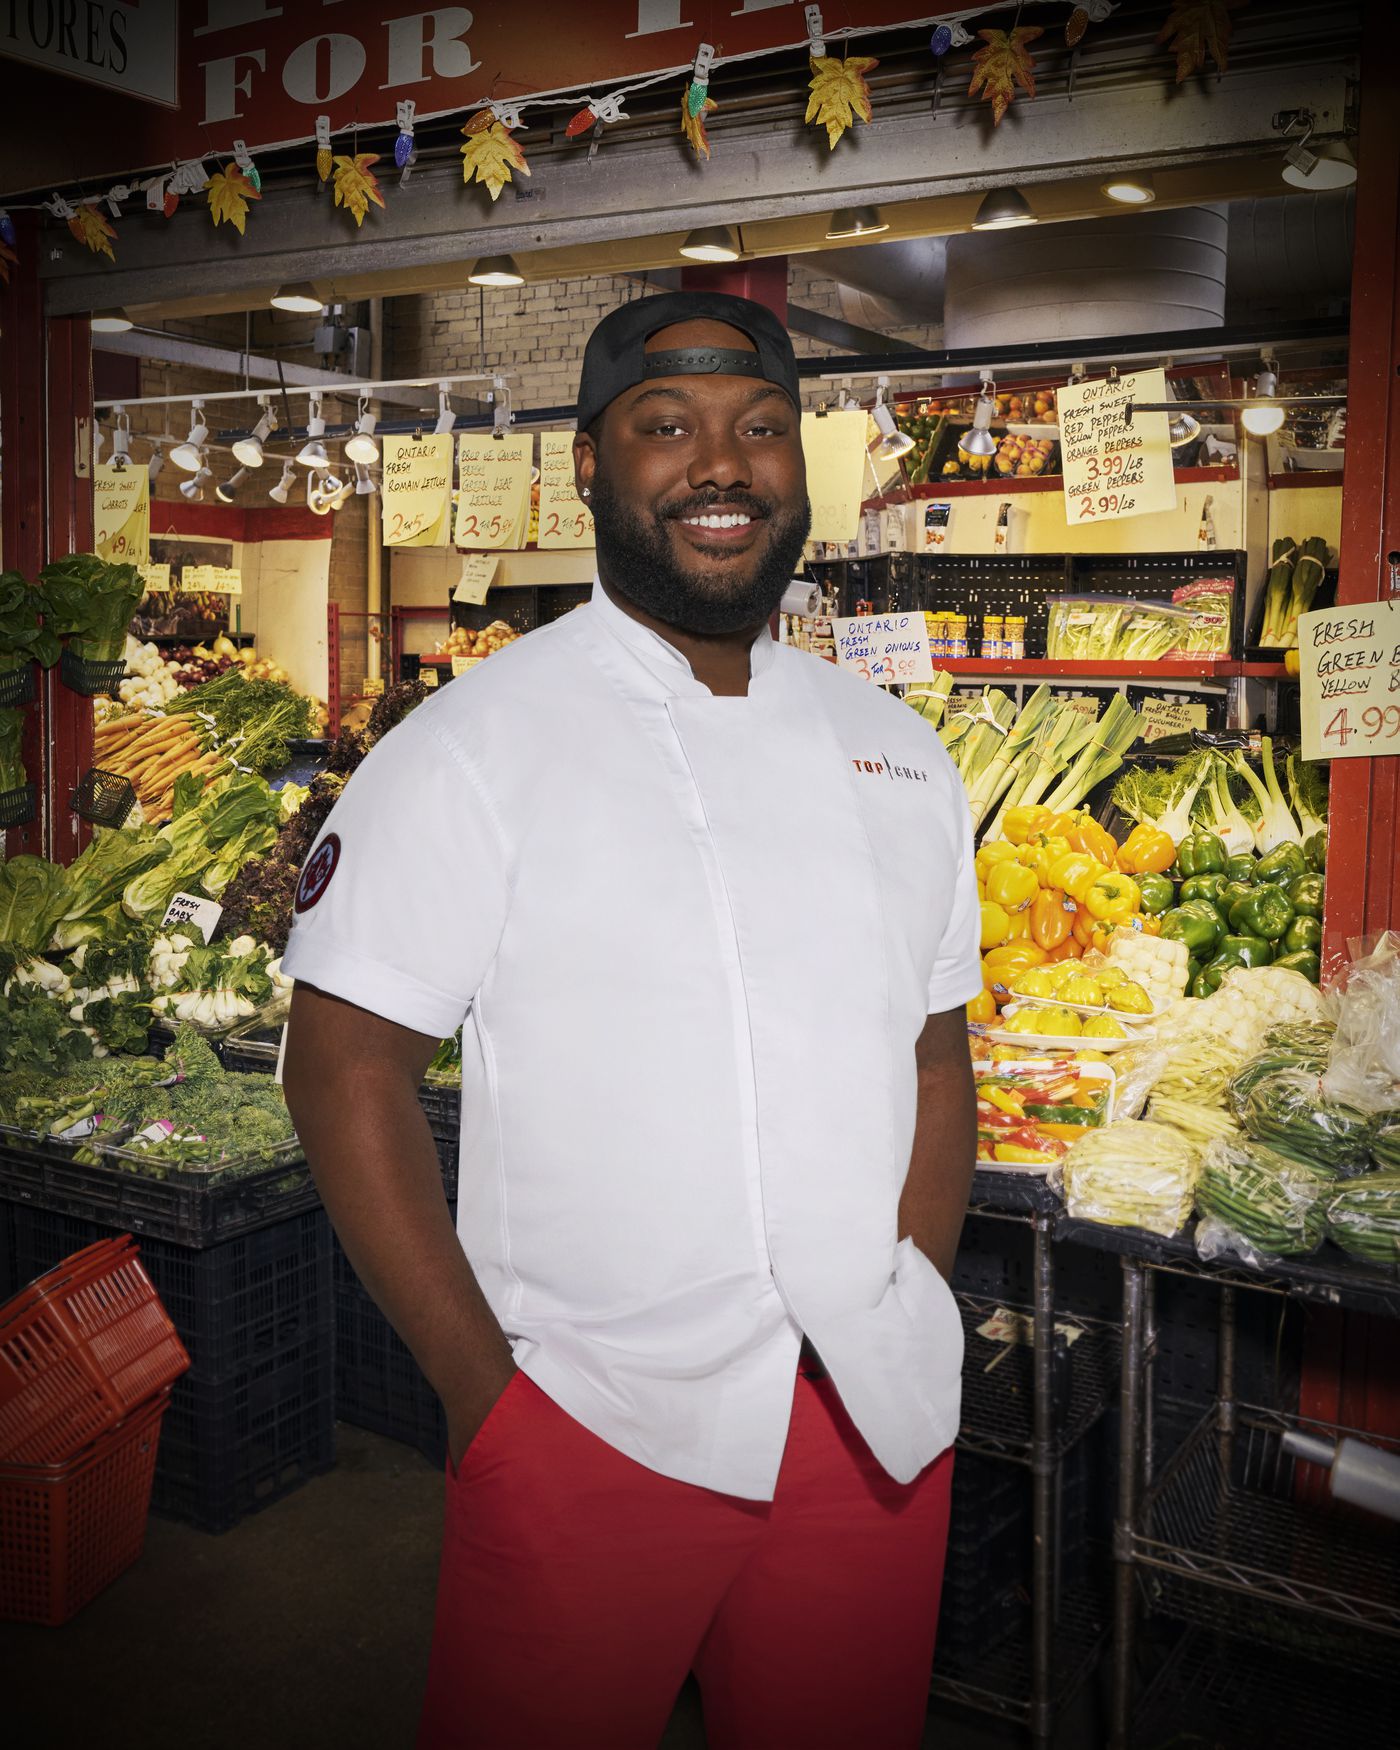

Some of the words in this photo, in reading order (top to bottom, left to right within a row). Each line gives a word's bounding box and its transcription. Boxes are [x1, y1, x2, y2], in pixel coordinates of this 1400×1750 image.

[198, 6, 482, 126] FOR
[1082, 378, 1136, 400] ONTARIO
[1063, 404, 1095, 423] FRESH
[1099, 393, 1136, 412] SWEET
[1064, 421, 1084, 438] RED
[1091, 411, 1133, 431] PEPPER
[1065, 433, 1093, 447] YELLOW
[1098, 423, 1135, 443] PEPPERS
[397, 446, 437, 460] ONTARIO
[1066, 445, 1099, 460] ORANGE
[1104, 436, 1143, 454] PEPPERS
[386, 462, 412, 474] FRESH
[388, 480, 419, 493] ROMAIN
[420, 477, 447, 489] LETTUCE
[1068, 481, 1100, 495] GREEN
[1106, 470, 1144, 490] PEPPERS
[388, 513, 403, 538] 2
[462, 514, 480, 537] 2
[544, 512, 561, 537] 2
[848, 617, 909, 635] ONTARIO
[1313, 619, 1375, 646] FRESH
[839, 635, 869, 650] FRESH
[845, 646, 878, 660] GREEN
[884, 641, 921, 654] ONIONS
[1317, 650, 1384, 674] GREEN
[1321, 676, 1372, 695] YELLOW
[1157, 703, 1190, 716] ONTARIO
[1323, 704, 1400, 747] 4.99
[852, 759, 884, 775] TOP
[894, 765, 928, 782] CHEF
[168, 907, 194, 922] BABY
[172, 896, 201, 910] FRESH
